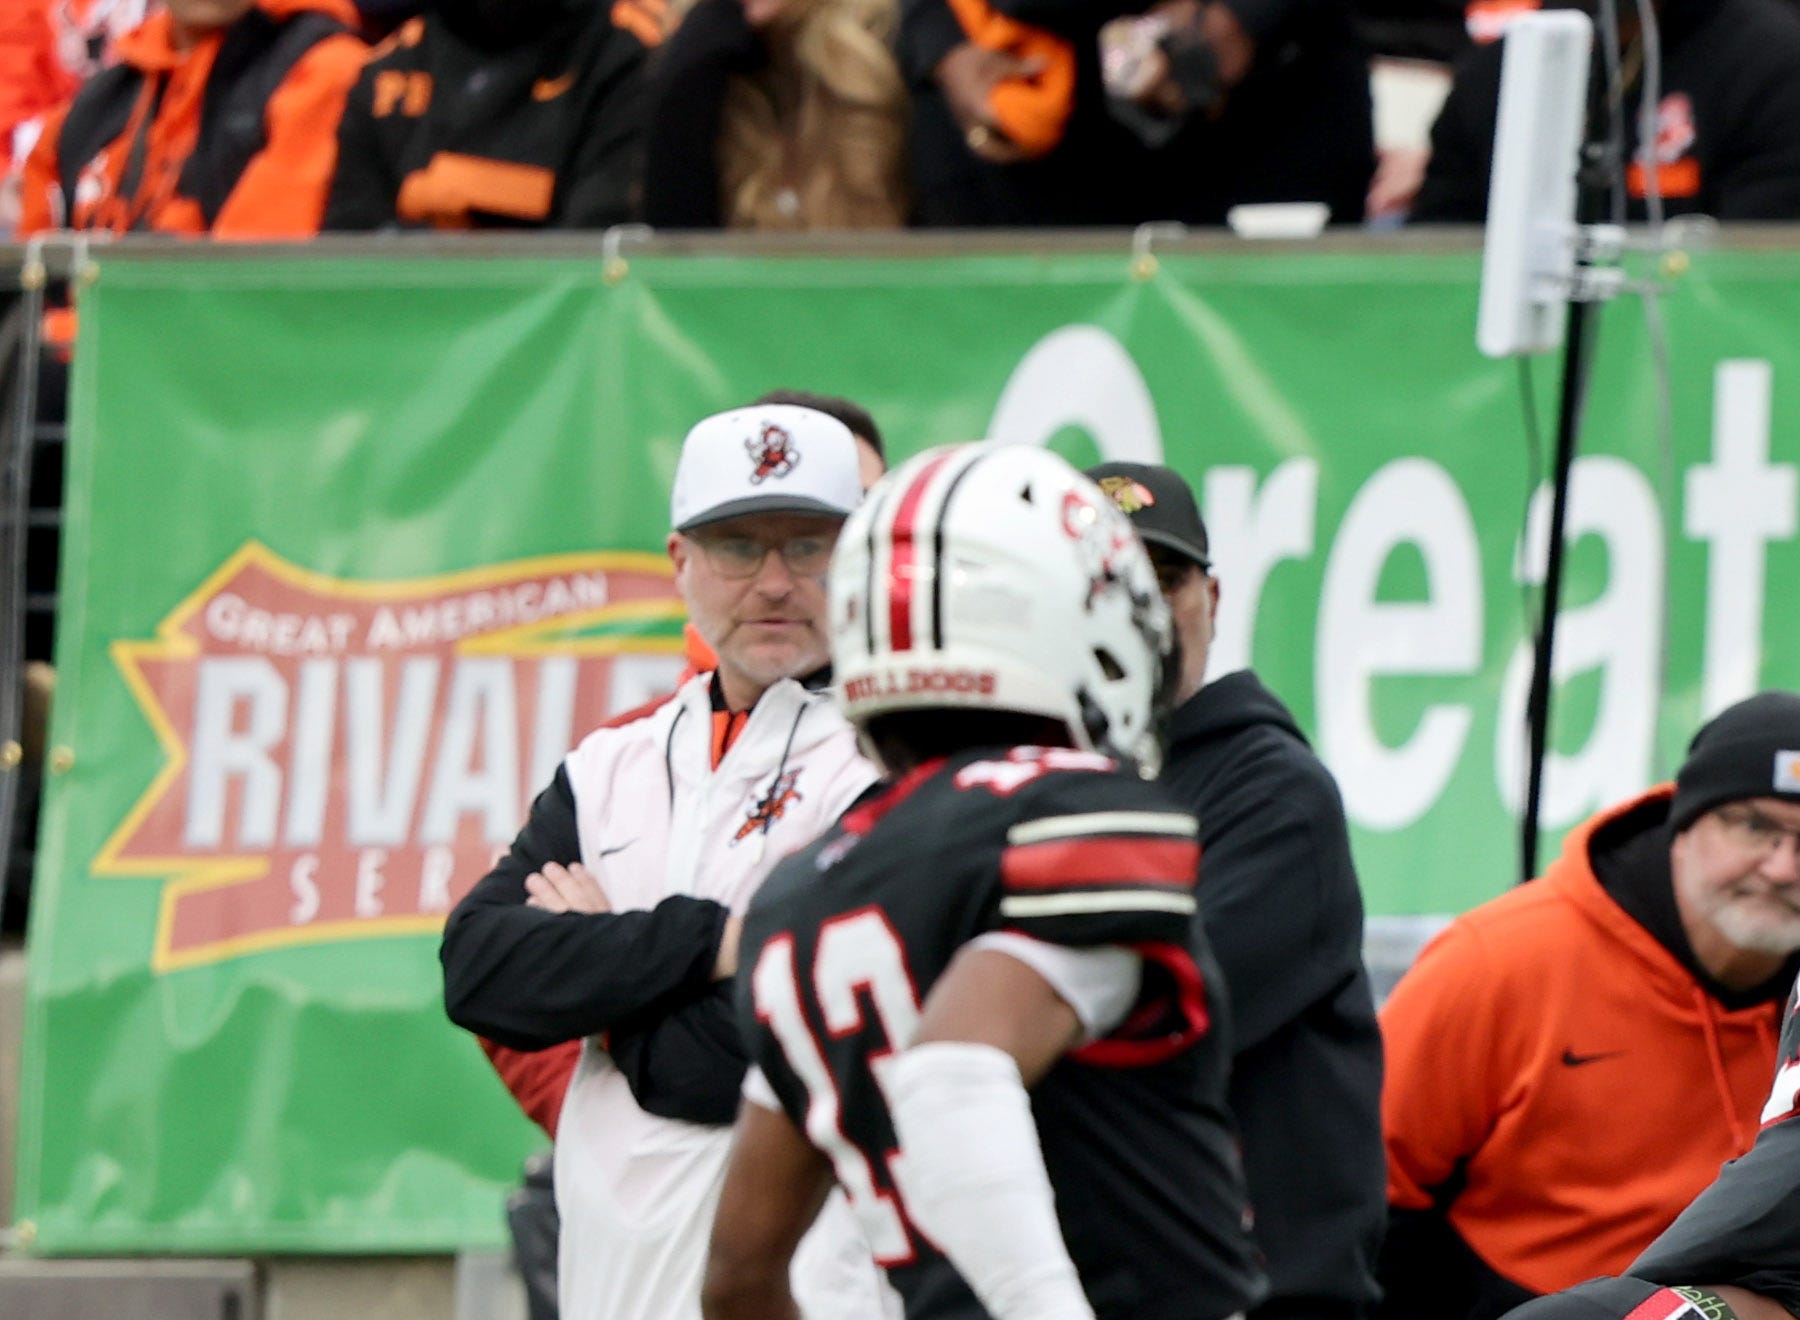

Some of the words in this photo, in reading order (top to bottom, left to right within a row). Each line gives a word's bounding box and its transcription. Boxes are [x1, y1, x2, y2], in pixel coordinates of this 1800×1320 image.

[206, 592, 357, 655] GREAT
[365, 570, 609, 652] AMERICAN
[288, 848, 455, 925] SER
